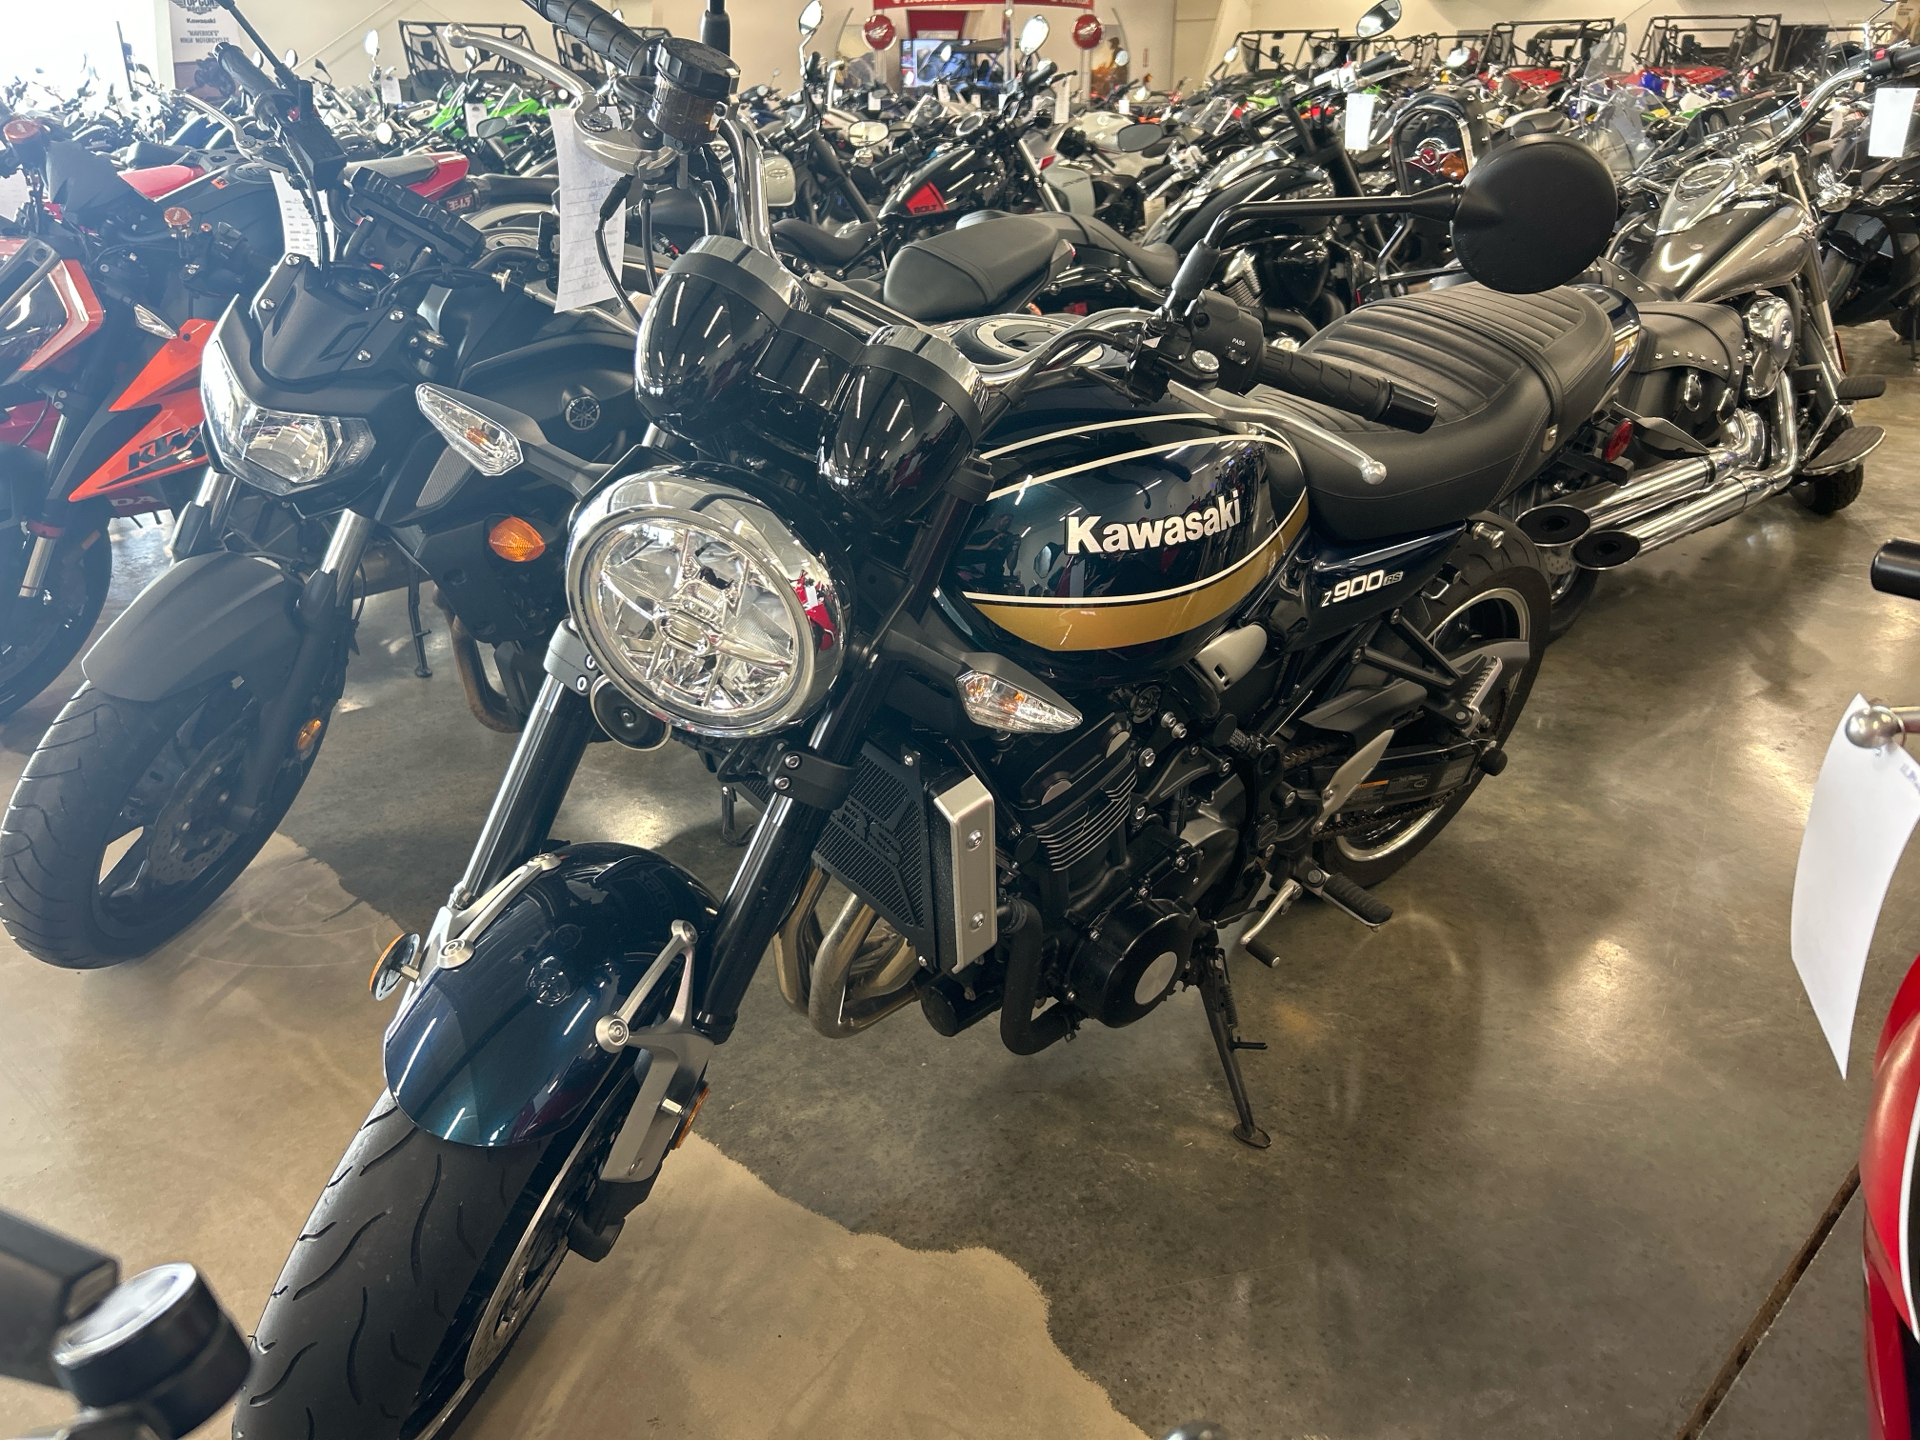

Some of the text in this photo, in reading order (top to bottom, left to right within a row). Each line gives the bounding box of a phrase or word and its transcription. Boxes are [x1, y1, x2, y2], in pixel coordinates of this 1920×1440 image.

[1231, 337, 1246, 347] PASS
[128, 424, 200, 472] KTM
[1065, 489, 1241, 555] Kawasaki
